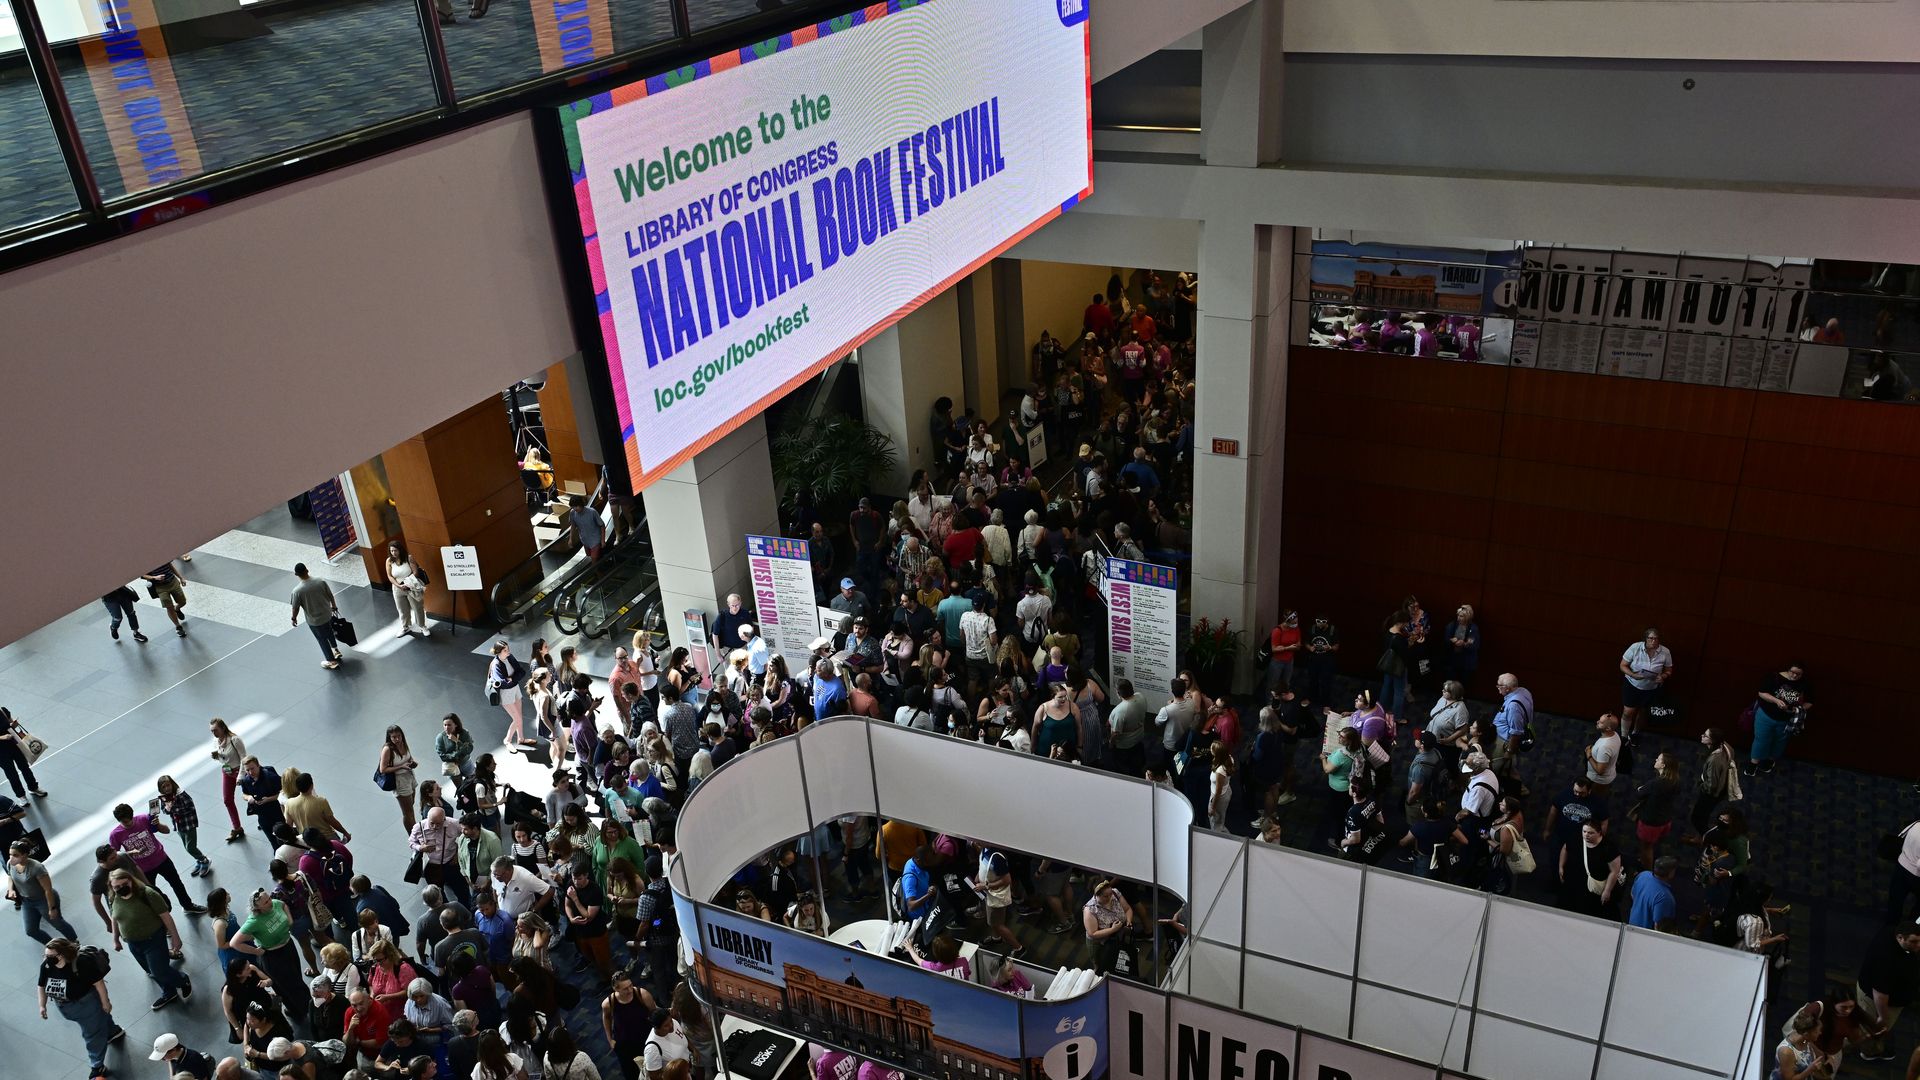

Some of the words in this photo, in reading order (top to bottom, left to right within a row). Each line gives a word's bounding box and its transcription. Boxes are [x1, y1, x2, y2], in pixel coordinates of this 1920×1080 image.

[614, 122, 753, 203] Welcome
[757, 113, 786, 145] to
[790, 93, 832, 130] the
[624, 198, 715, 259] LIBRARY
[719, 183, 746, 215] OF
[747, 140, 839, 203] CONGRESS
[631, 194, 814, 370] NATIONAL
[813, 150, 899, 271] BOOK
[900, 96, 1006, 225] FESTIVAL
[653, 303, 812, 414] loc.gov/bookfest
[1216, 441, 1233, 454] EXIT
[752, 558, 773, 588] WEST
[757, 590, 778, 625] SALON
[1110, 583, 1130, 614] WEST
[1111, 616, 1131, 652] SALON
[707, 922, 773, 966] LIBRARY
[734, 955, 759, 967] LIBRARY
[743, 962, 774, 976] CONGRESS
[753, 1043, 777, 1067] BOOKTV
